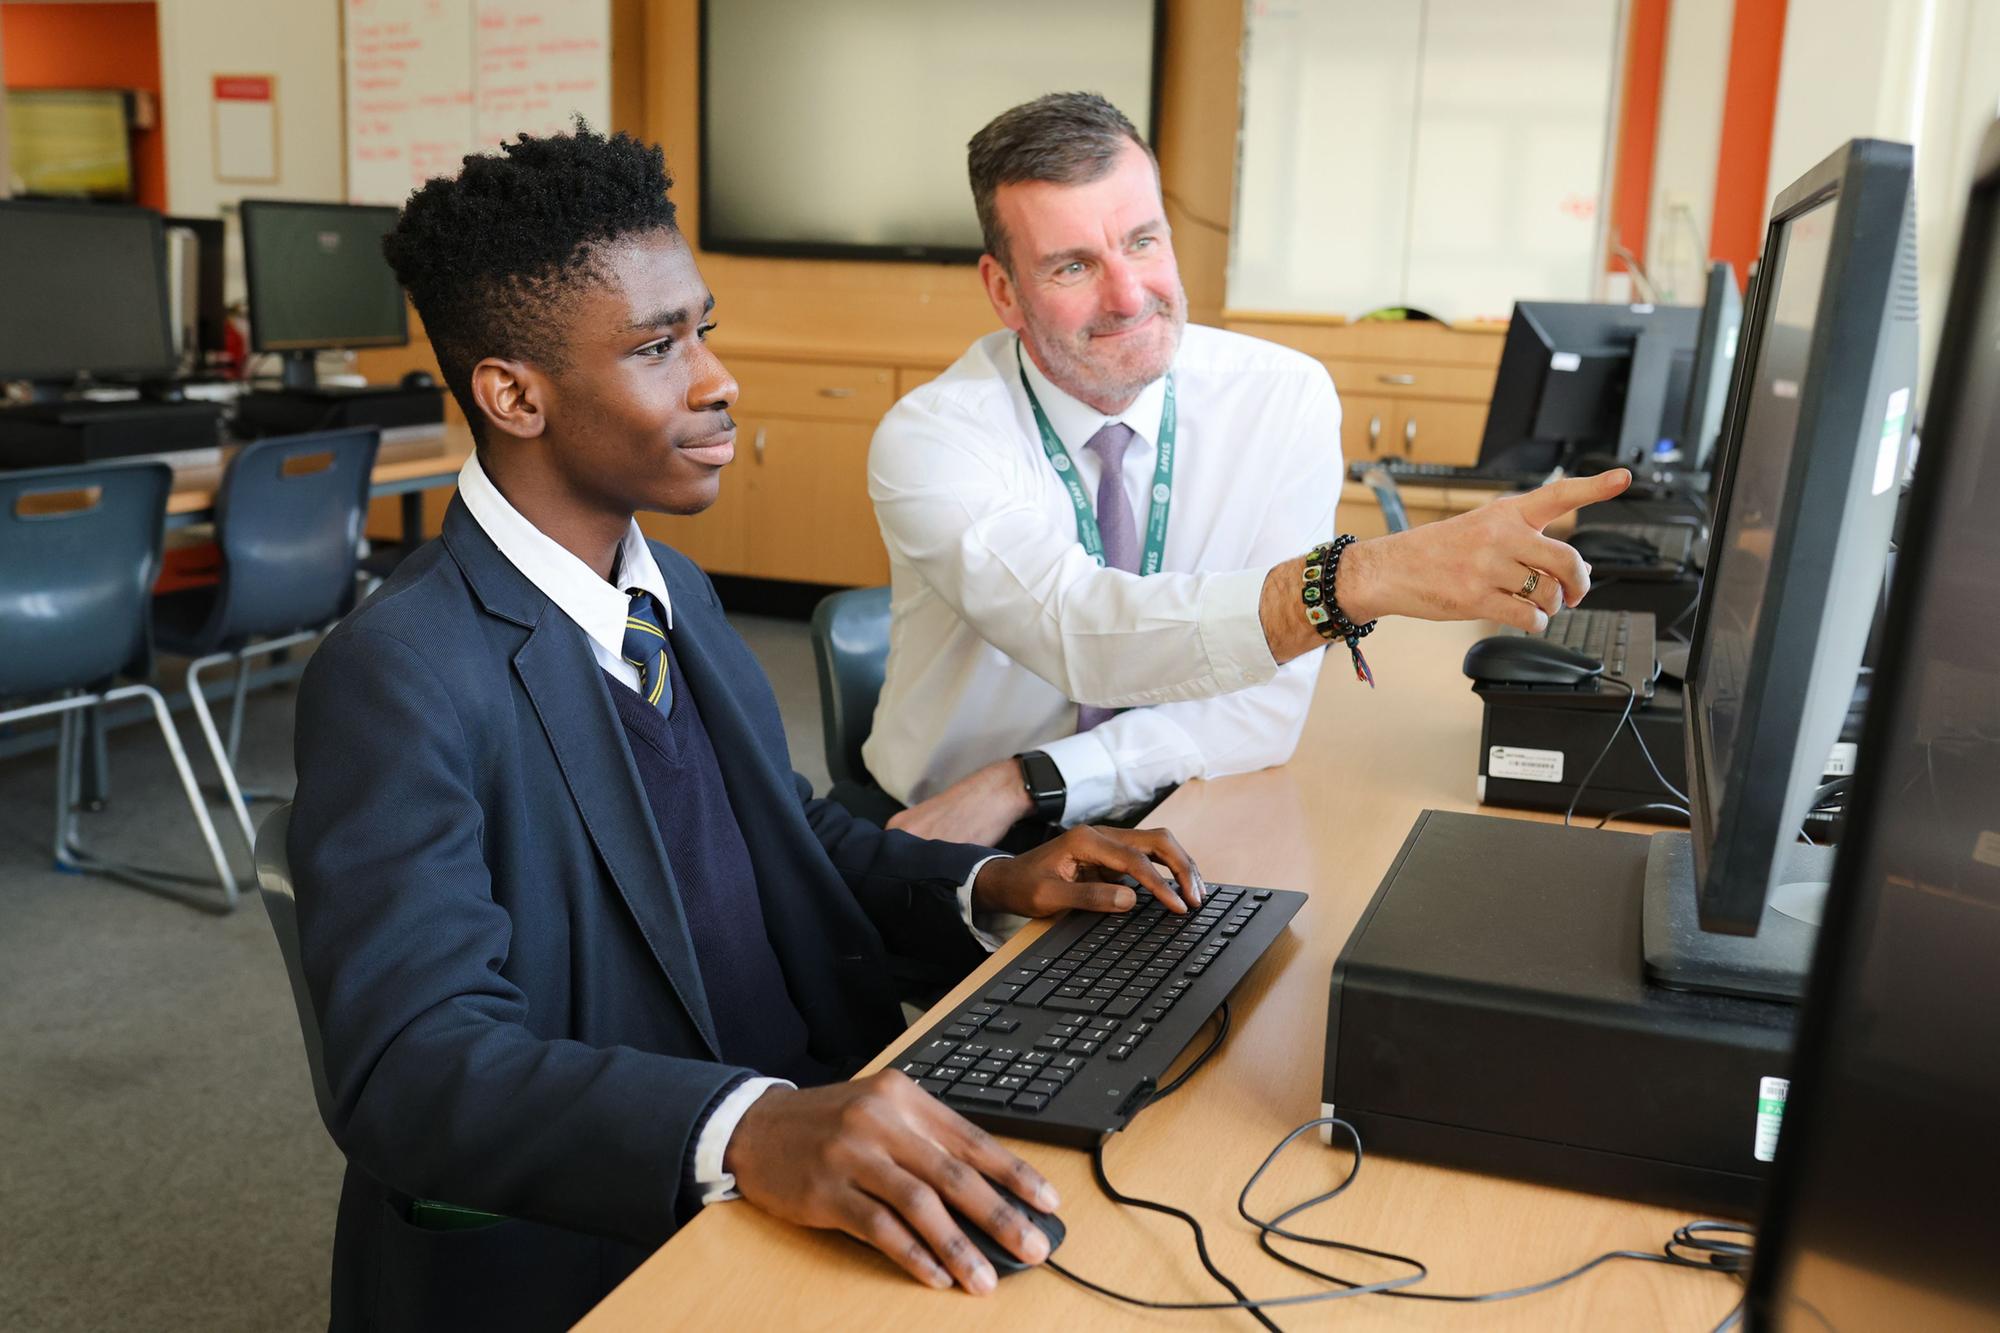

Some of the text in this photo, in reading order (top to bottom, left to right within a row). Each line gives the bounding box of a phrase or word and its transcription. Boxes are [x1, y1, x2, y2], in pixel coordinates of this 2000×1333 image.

[1160, 442, 1171, 474] STAFF
[1068, 480, 1087, 509] STAFF
[1146, 551, 1159, 575] STA
